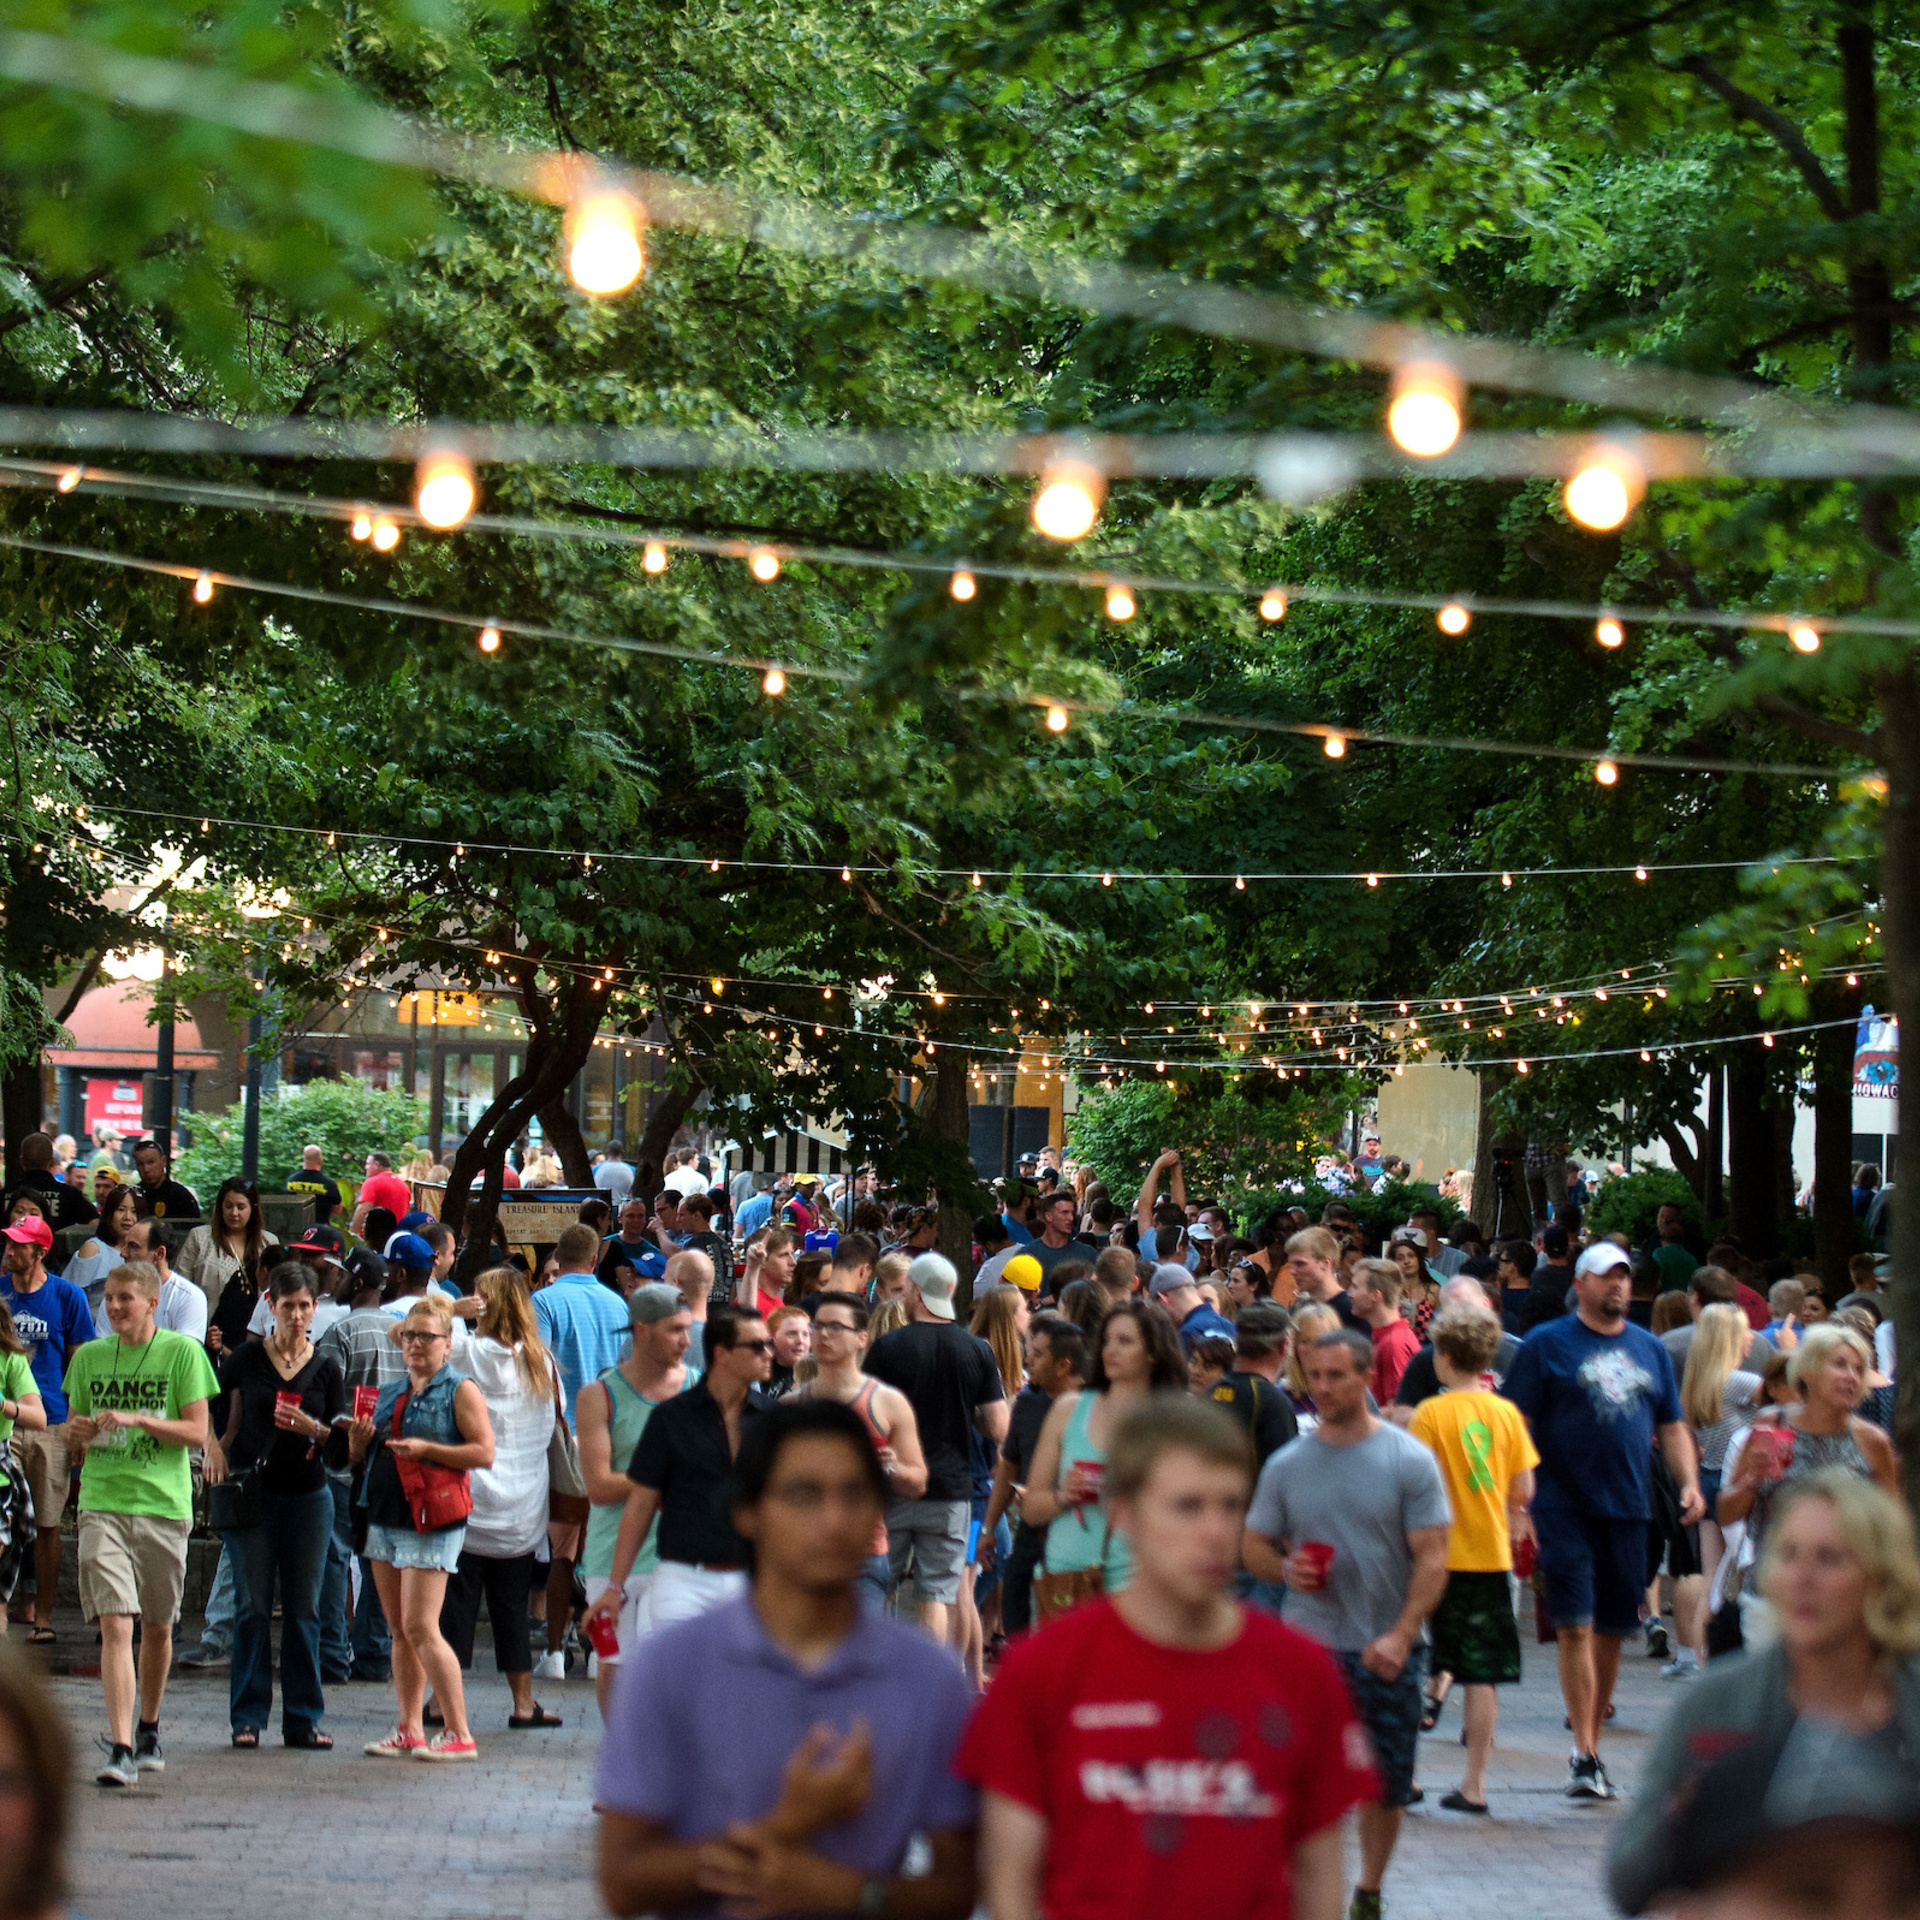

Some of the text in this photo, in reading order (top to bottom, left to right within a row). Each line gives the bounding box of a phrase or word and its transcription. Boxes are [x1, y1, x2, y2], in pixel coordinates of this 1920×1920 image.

[506, 1205, 548, 1214] TREASURE
[19, 1321, 48, 1333] FUJI
[90, 1380, 169, 1398] DANCE
[92, 1398, 167, 1410] MARATHON
